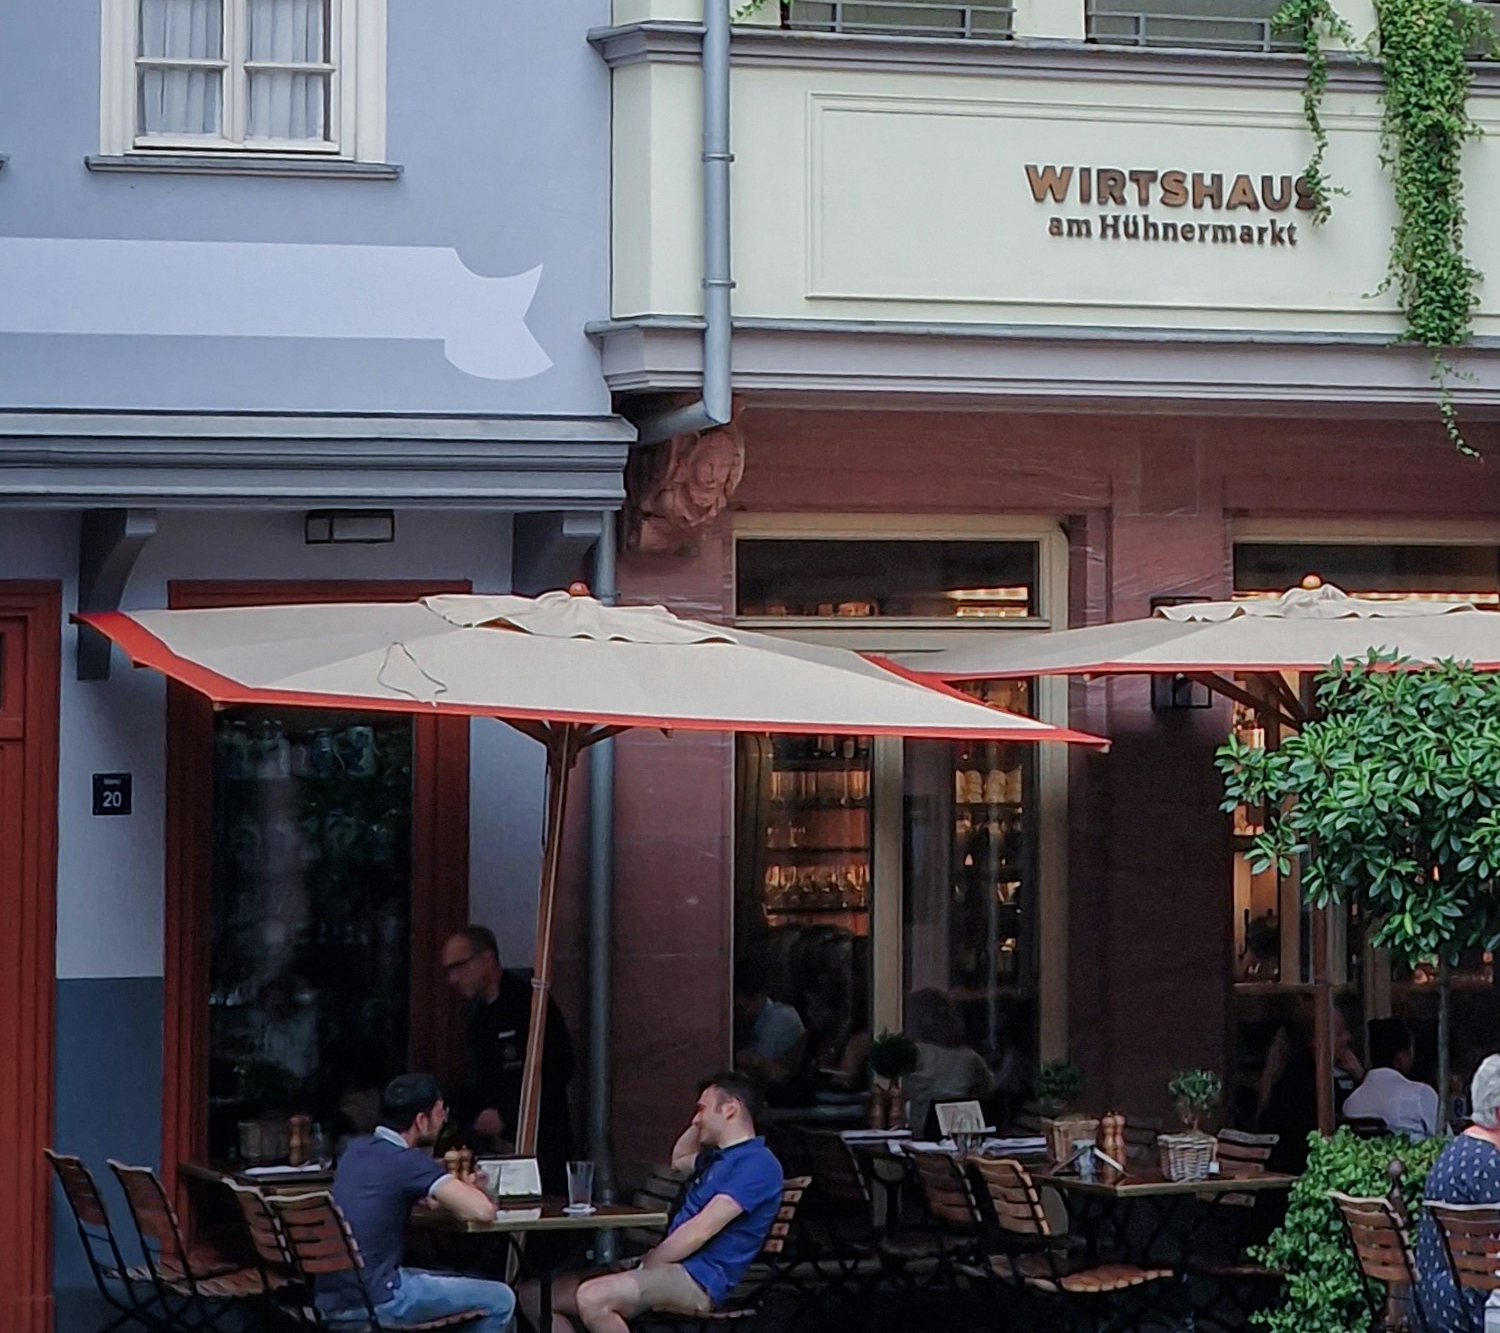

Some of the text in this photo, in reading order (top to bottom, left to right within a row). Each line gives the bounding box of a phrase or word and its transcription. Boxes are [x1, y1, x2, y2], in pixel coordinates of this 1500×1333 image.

[1025, 164, 1317, 211] WIRTSHAUS
[1049, 214, 1298, 246] am Hühnermarkt
[102, 791, 122, 808] 20
